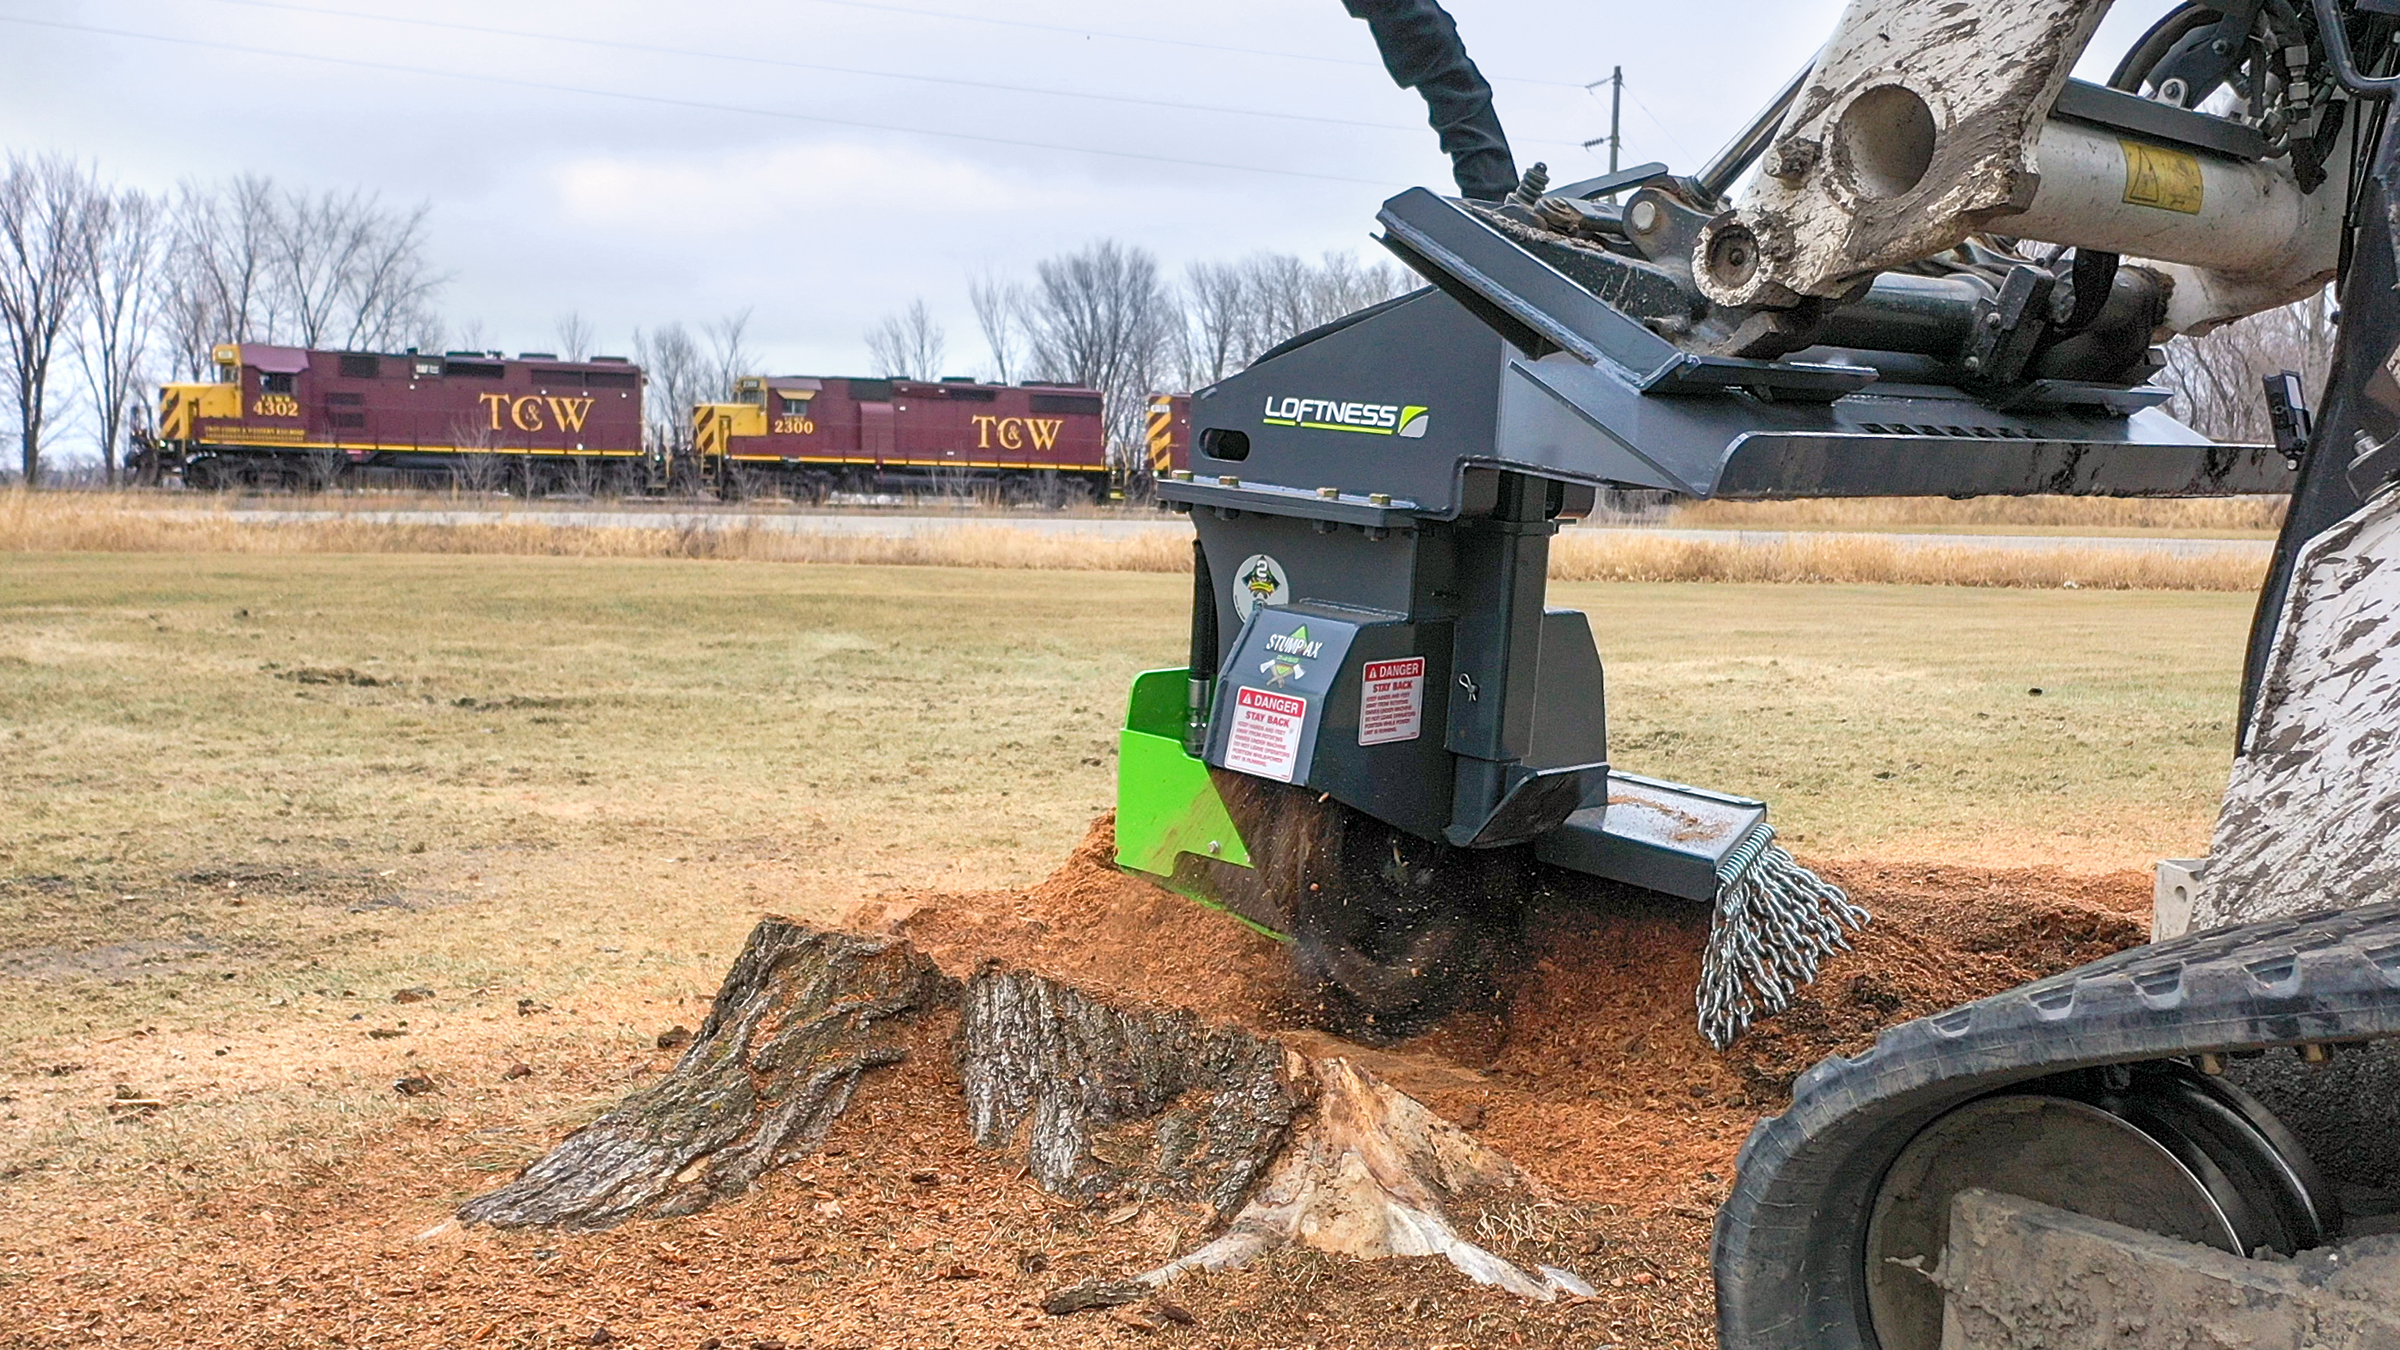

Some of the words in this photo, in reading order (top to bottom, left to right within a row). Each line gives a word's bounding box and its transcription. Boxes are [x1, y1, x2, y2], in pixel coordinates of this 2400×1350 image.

[253, 400, 299, 417] 4302
[1264, 396, 1398, 427] LOFTNESS
[774, 419, 814, 435] 2300
[1256, 560, 1268, 578] 2
[1380, 662, 1419, 678] DANGER
[1373, 683, 1391, 693] STAY
[1393, 680, 1413, 691] BACK
[1254, 695, 1299, 714] DANGER
[1245, 711, 1264, 722] STAY
[1267, 716, 1290, 728] BACK
